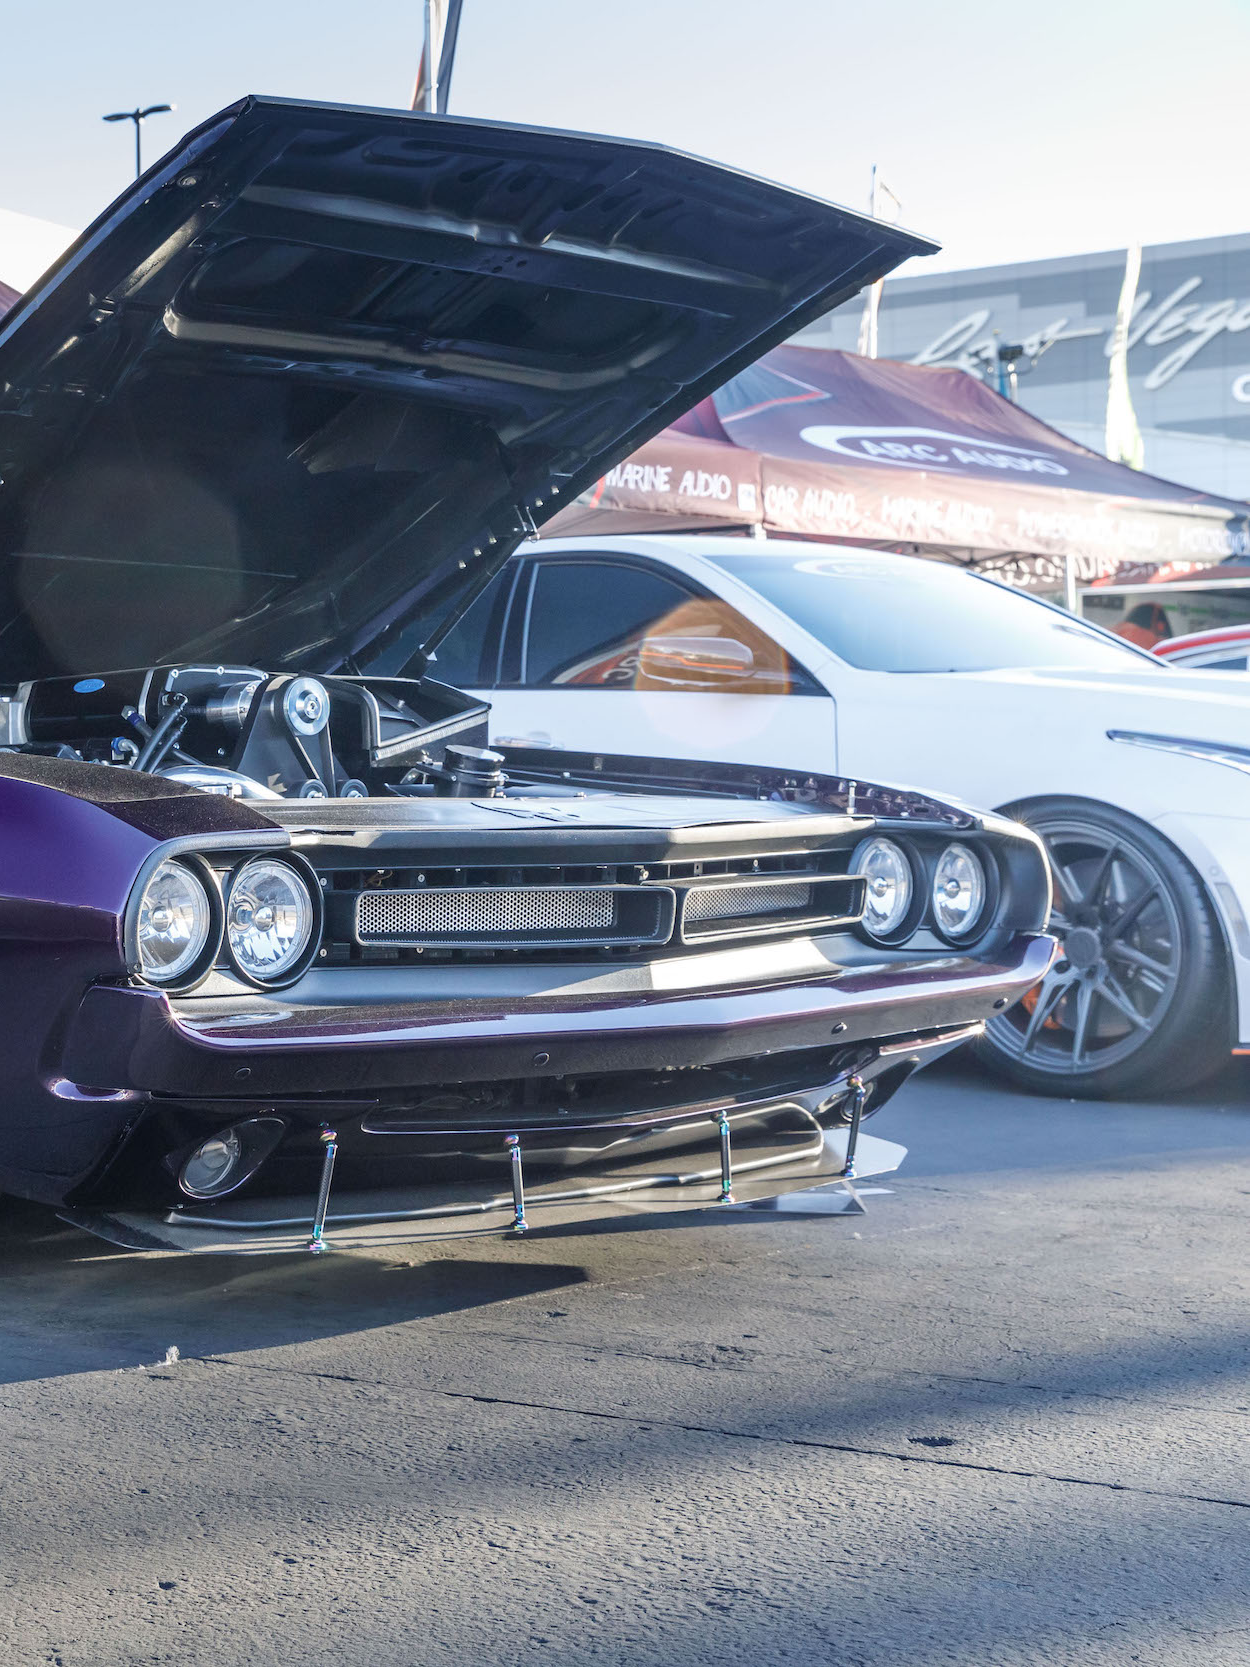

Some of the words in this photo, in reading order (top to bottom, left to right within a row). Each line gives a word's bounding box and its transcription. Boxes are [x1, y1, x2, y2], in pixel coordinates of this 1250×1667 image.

[860, 439, 949, 462] ARC
[951, 447, 1070, 476] AUDIO
[678, 469, 731, 500] AUDIO
[764, 485, 799, 515] CAR
